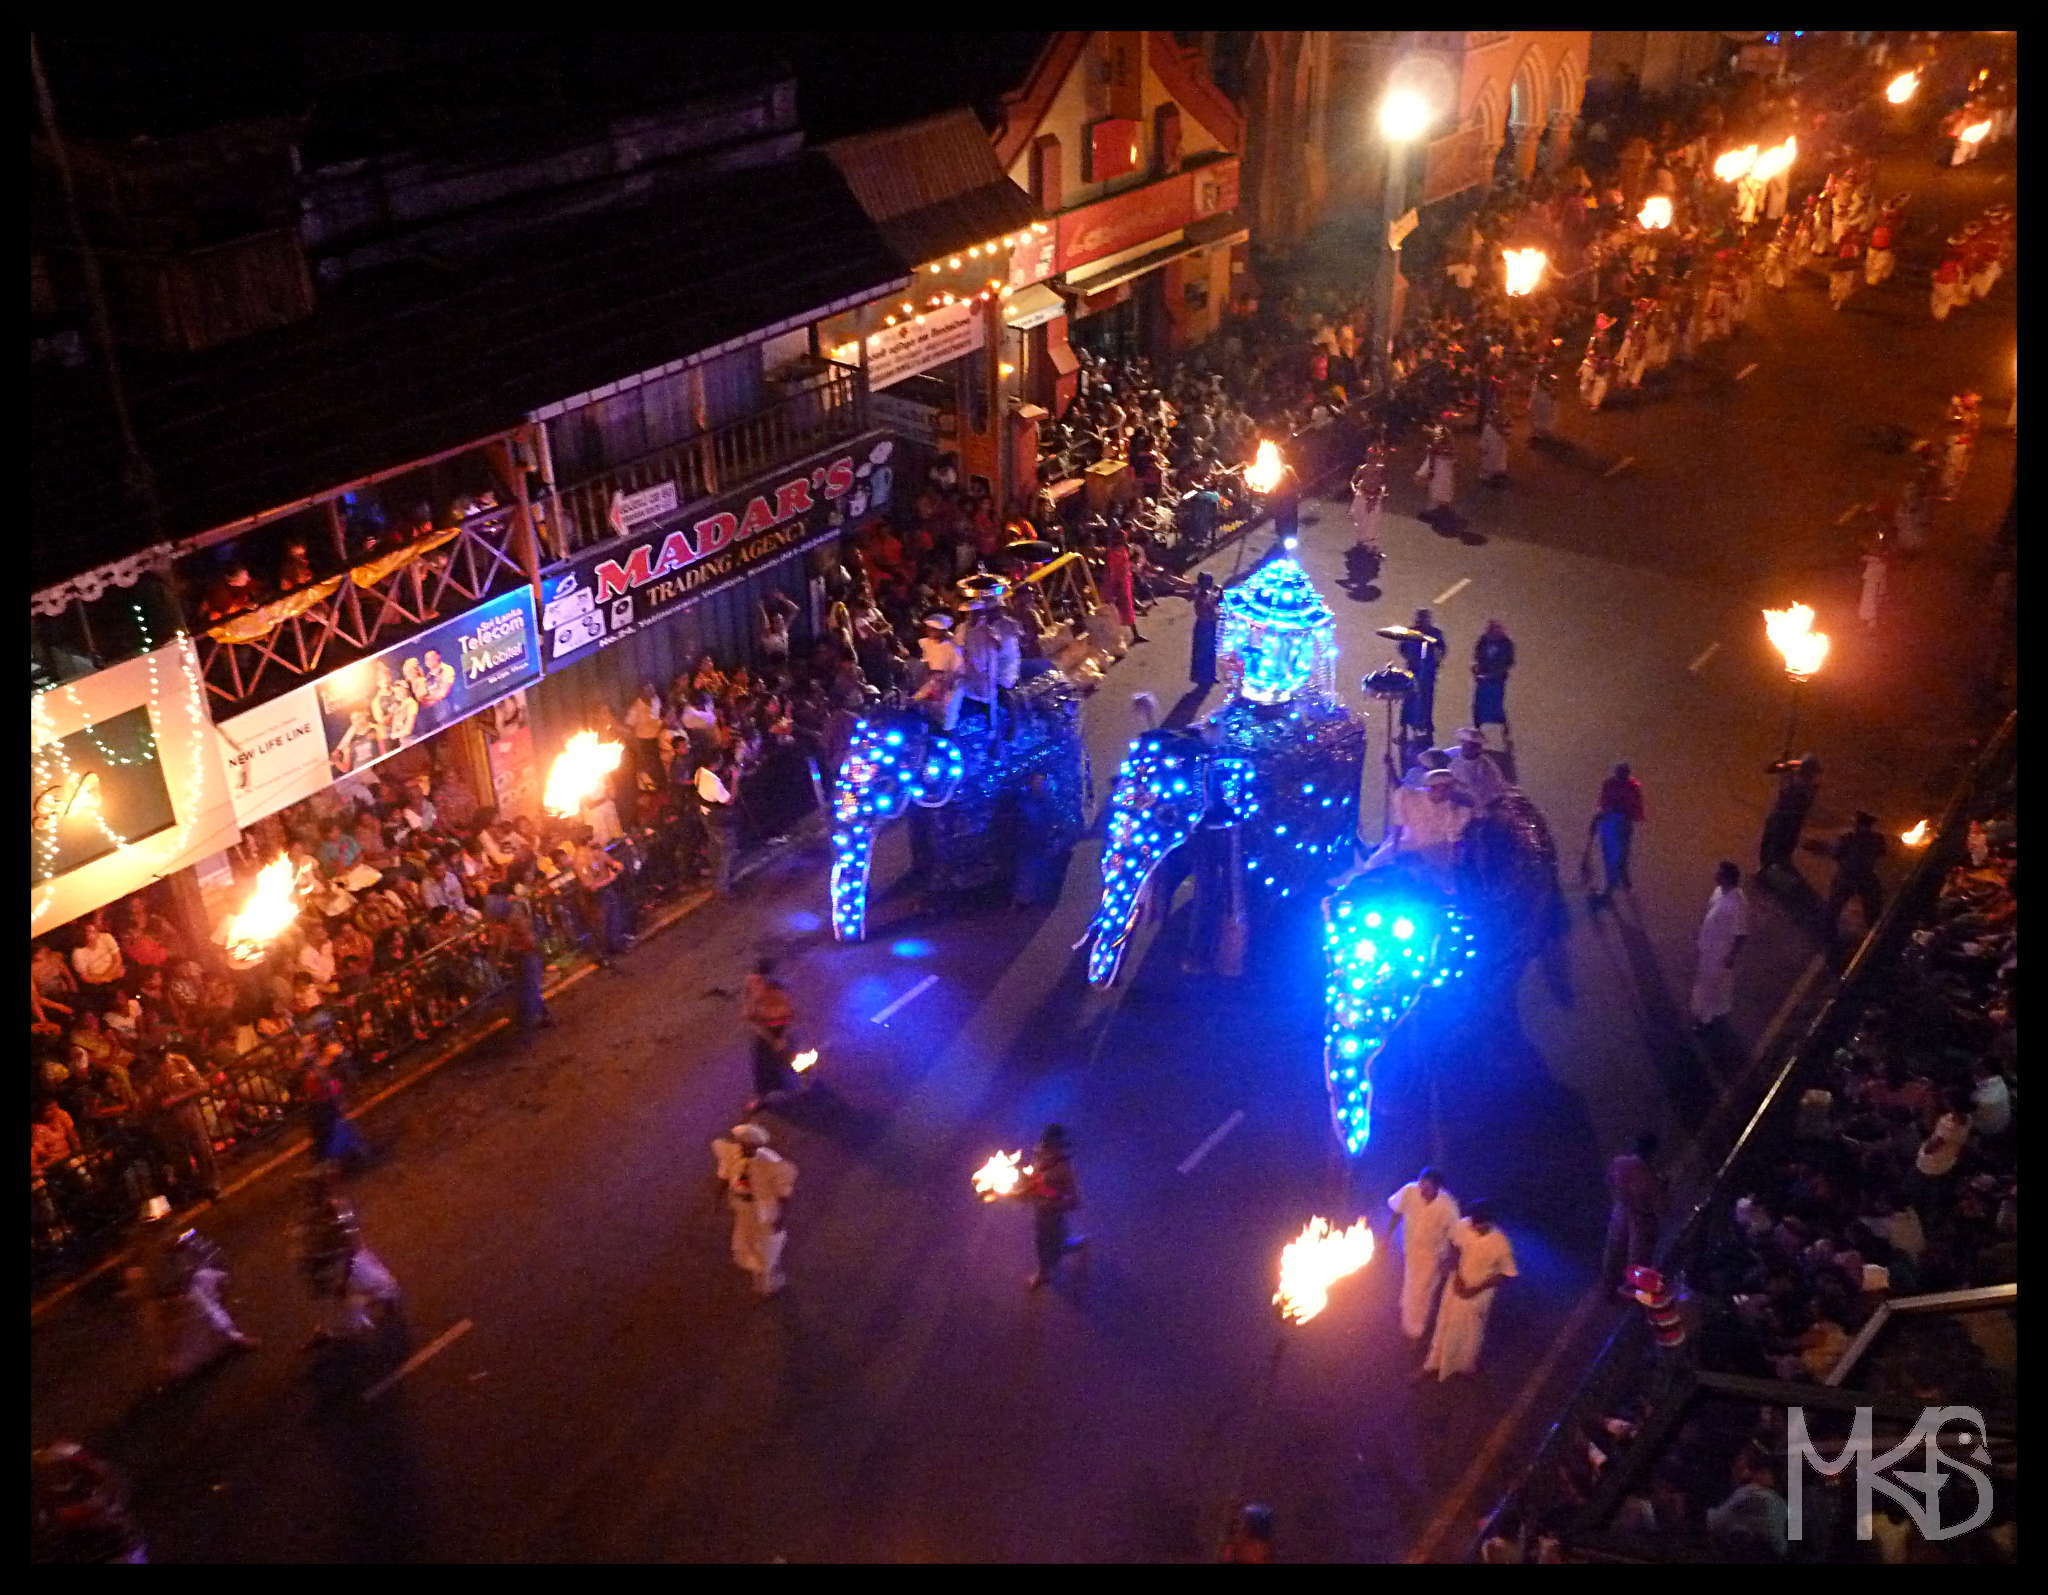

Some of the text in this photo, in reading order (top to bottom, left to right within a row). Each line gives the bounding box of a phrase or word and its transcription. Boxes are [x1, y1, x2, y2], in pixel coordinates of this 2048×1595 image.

[594, 456, 855, 604] MADAR'S
[646, 552, 733, 606] TRADING
[736, 520, 807, 564] AGENCY
[458, 616, 525, 654] Telecom
[469, 642, 524, 680] Mobitel
[228, 748, 255, 768] NEW
[258, 735, 284, 755] LIFE
[286, 722, 312, 742] LINE
